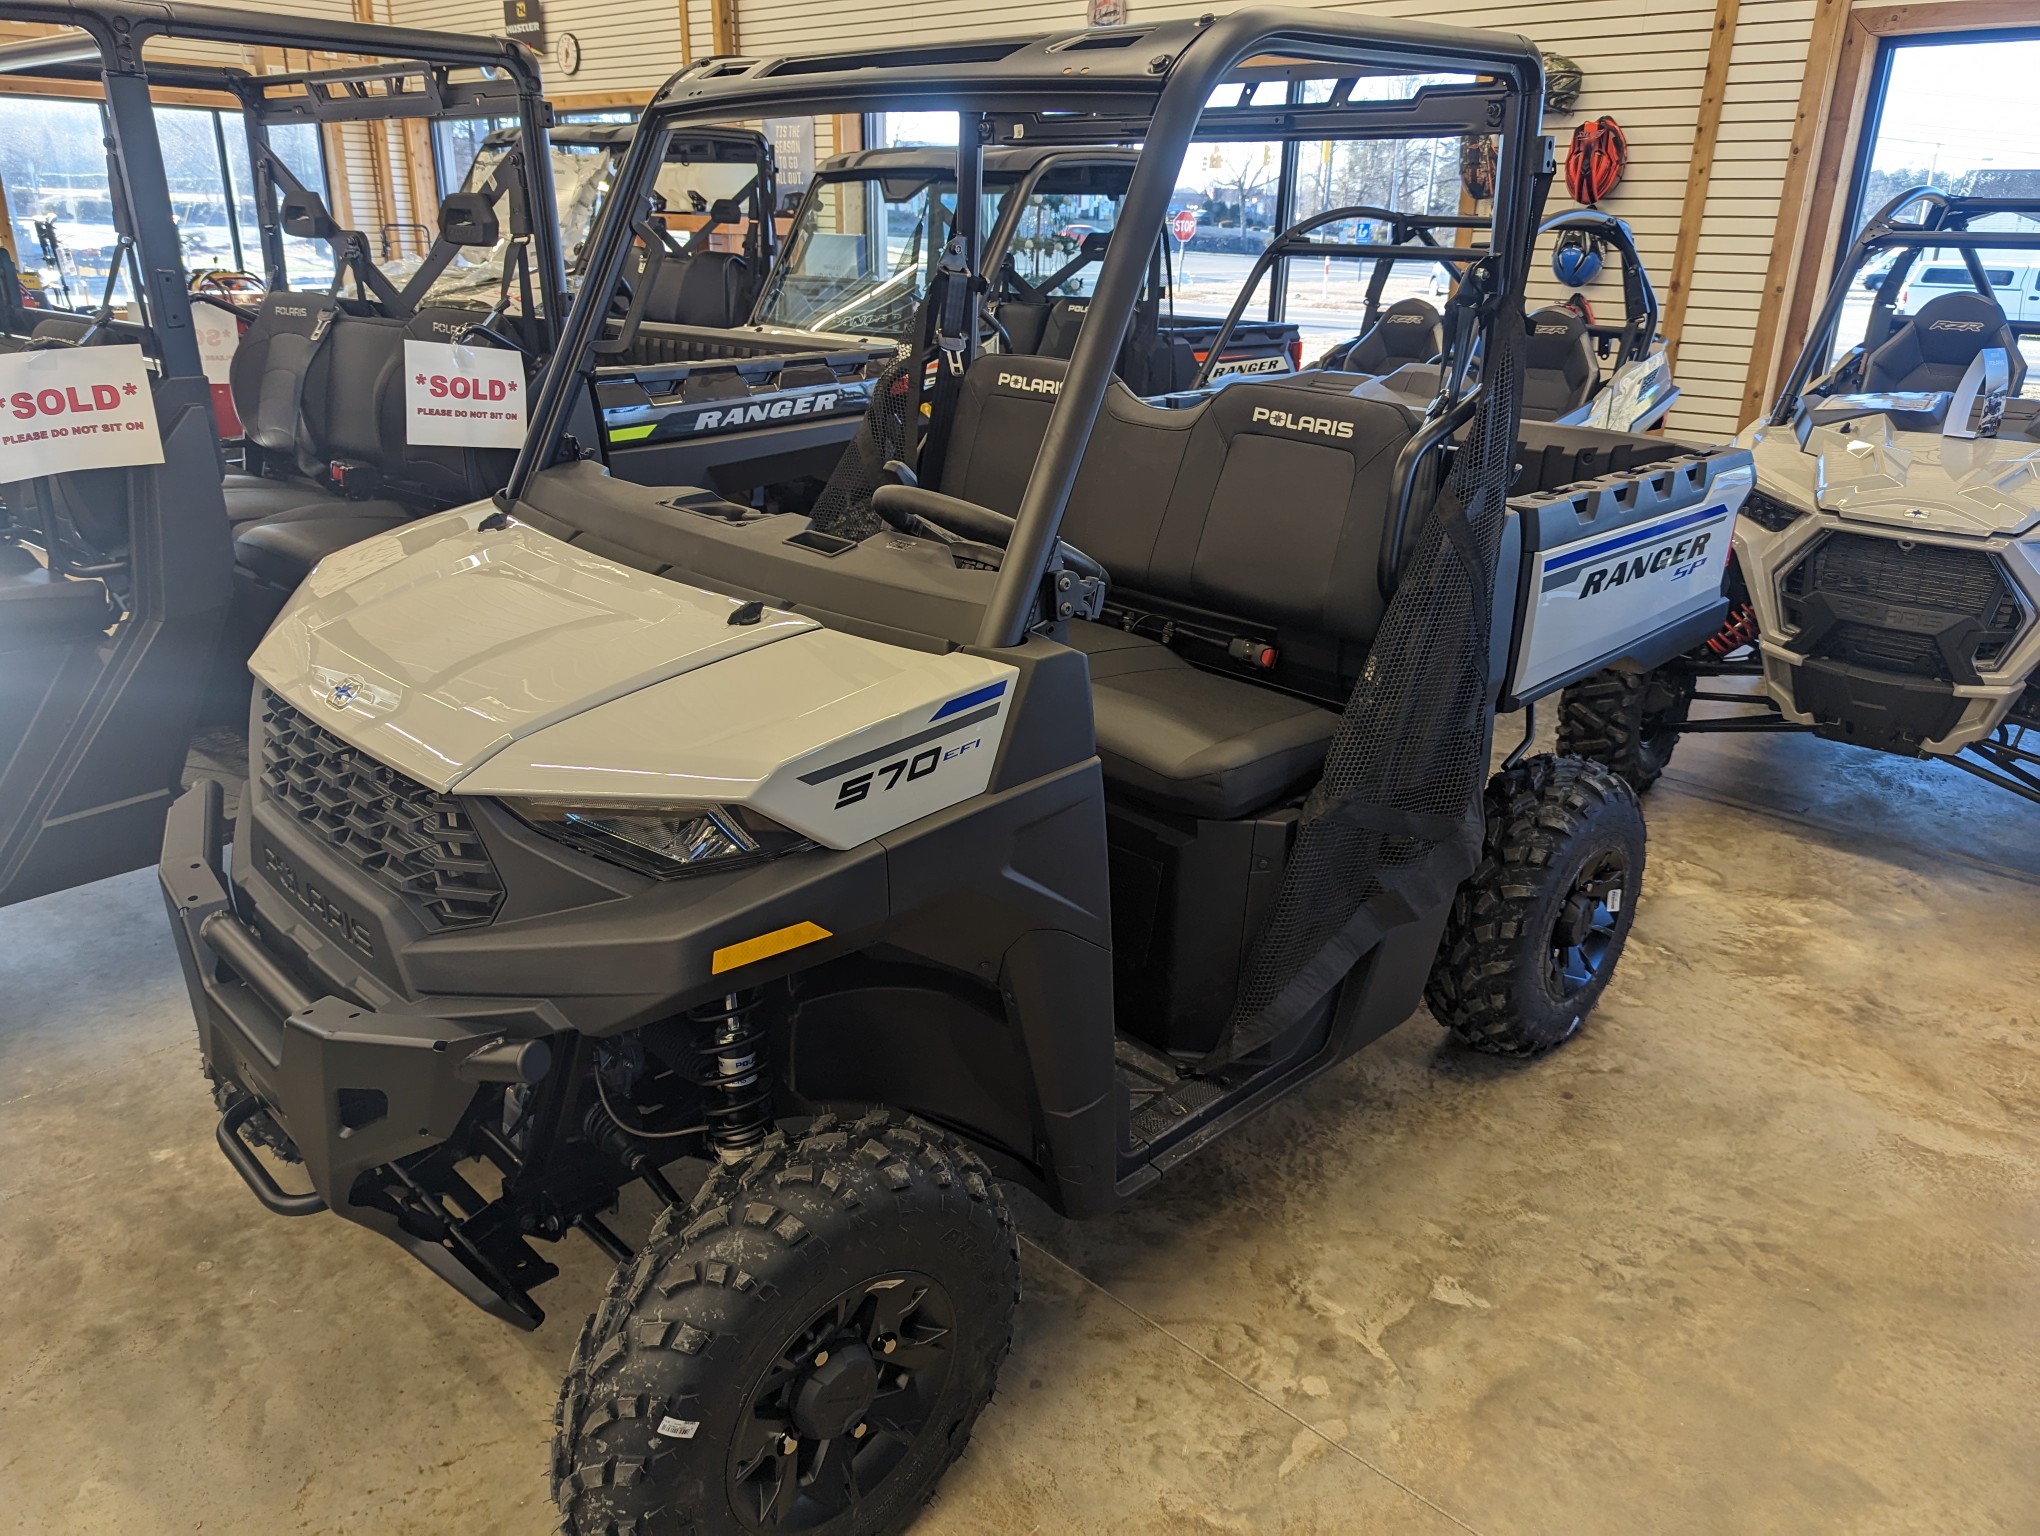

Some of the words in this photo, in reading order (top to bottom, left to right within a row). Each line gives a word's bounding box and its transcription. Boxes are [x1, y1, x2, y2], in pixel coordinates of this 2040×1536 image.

[506, 22, 540, 34] HUSTLER
[789, 125, 801, 138] THE
[775, 140, 801, 154] SEASON
[779, 156, 788, 169] TO
[788, 156, 799, 169] GO
[776, 172, 787, 185] ALL
[1174, 220, 1194, 232] STOP
[275, 306, 307, 317] POLARIS
[1387, 315, 1424, 325] RZR
[1929, 320, 1985, 332] RZR
[1213, 360, 1279, 378] RANGER
[997, 372, 1064, 395] POLARI
[417, 407, 453, 417] PLEASE
[454, 410, 467, 418] DO
[470, 410, 488, 419] NOT
[490, 411, 504, 420] SIT
[505, 412, 517, 421] ON
[693, 393, 838, 431] RANGER
[1252, 406, 1354, 439] POLARIS
[2, 430, 49, 446] PLEASE
[51, 427, 69, 438] DO
[71, 424, 99, 436] NOT
[101, 422, 122, 433] SIT
[125, 421, 145, 431] ON
[1578, 532, 1711, 600] RANGER
[1670, 557, 1708, 582] SP
[833, 745, 943, 810] 570
[943, 738, 981, 762] EFI
[263, 847, 375, 959] POLARIS
